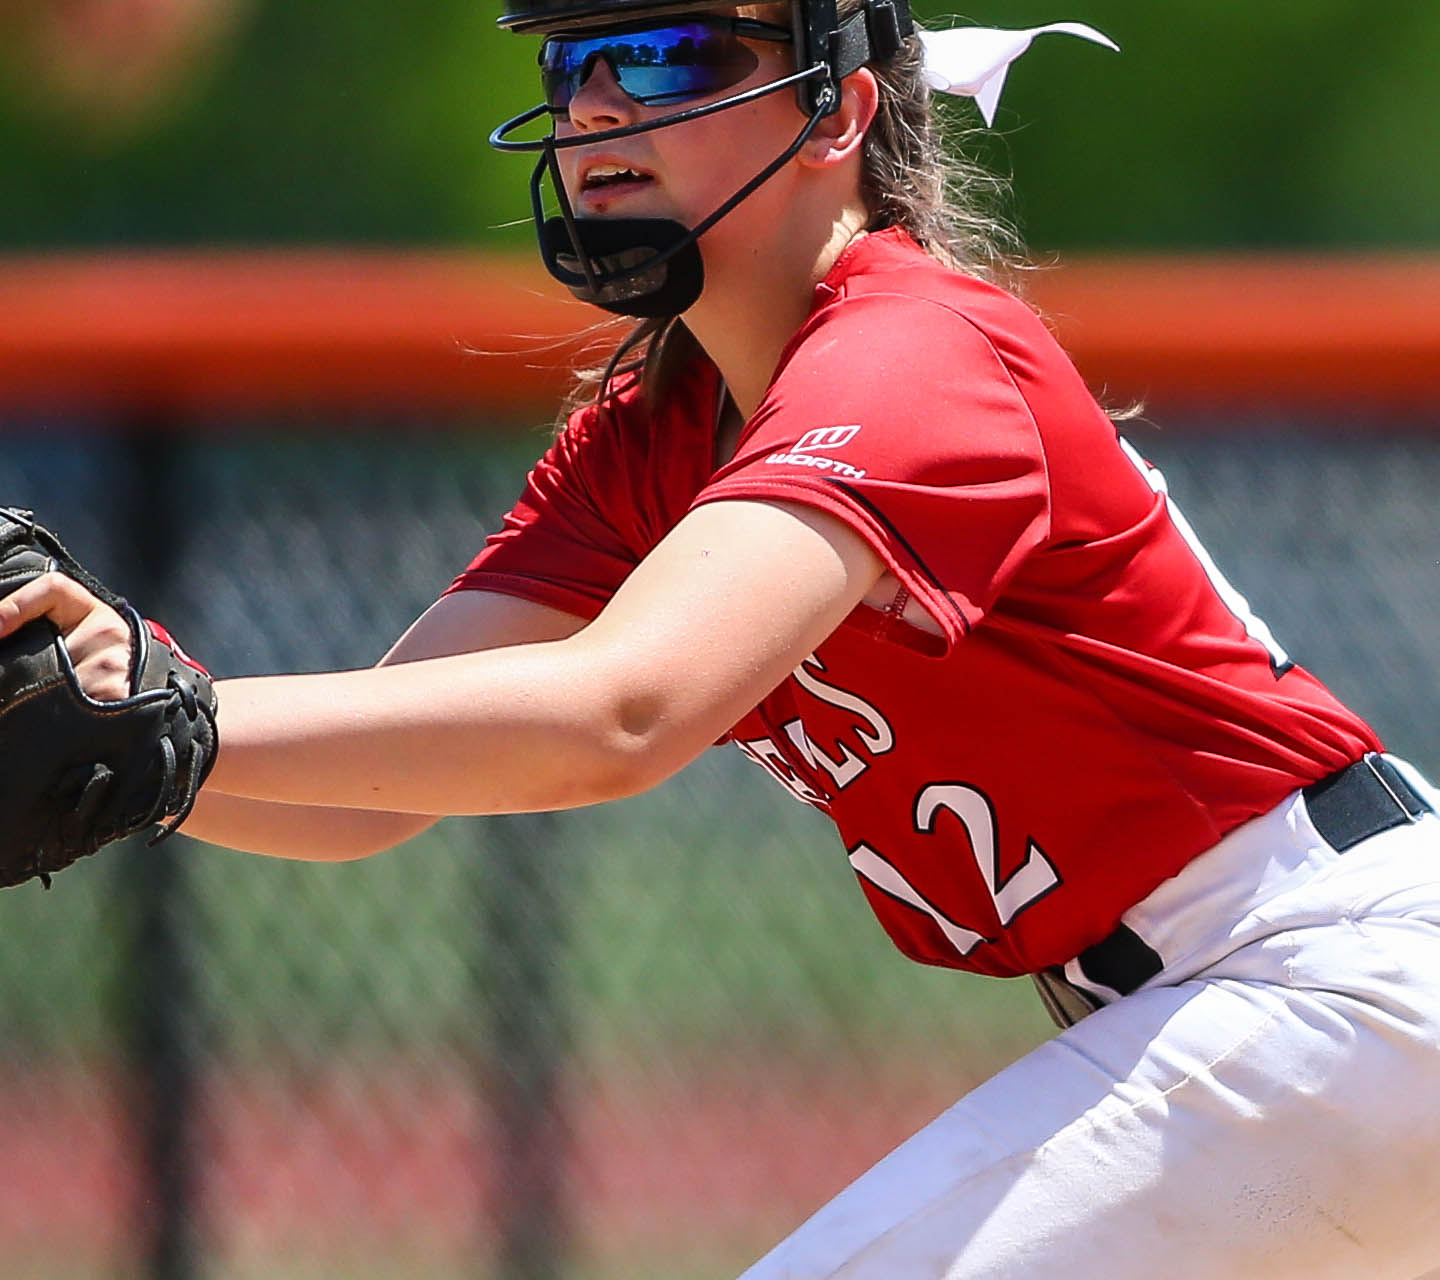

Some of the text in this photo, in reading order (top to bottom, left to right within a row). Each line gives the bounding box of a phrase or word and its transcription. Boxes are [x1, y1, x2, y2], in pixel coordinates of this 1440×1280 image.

[765, 453, 866, 480] WORTH
[732, 652, 894, 810] ELS
[847, 781, 1063, 957] 12
